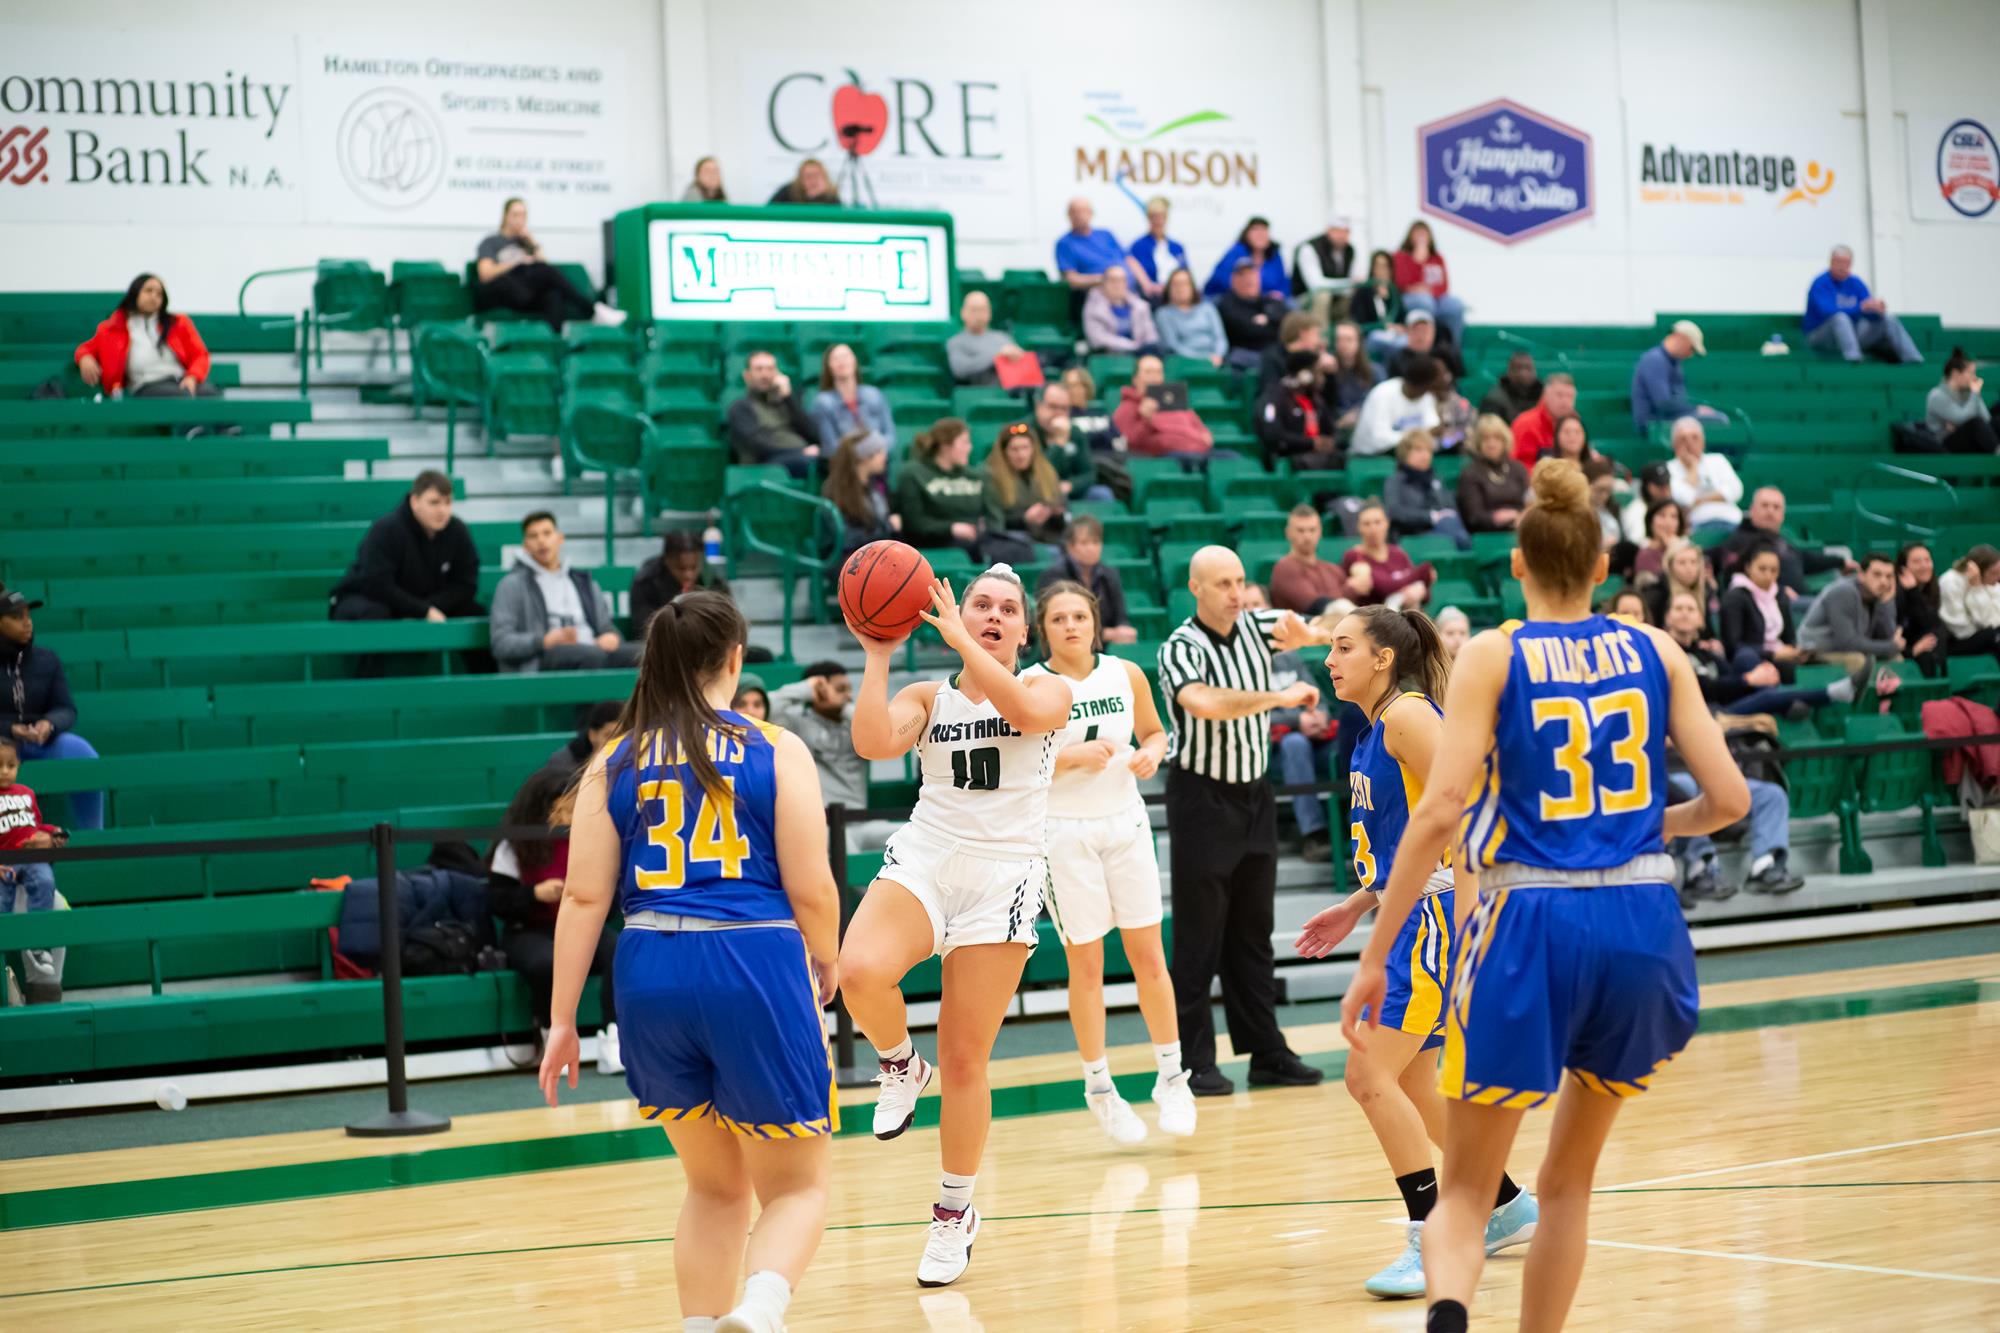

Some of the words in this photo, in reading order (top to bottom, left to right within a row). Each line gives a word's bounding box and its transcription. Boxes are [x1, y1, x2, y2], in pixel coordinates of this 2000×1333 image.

[65, 129, 212, 186] Bank
[1075, 146, 1258, 187] MADISON
[1642, 143, 1796, 192] Advantage
[1518, 629, 1643, 684] WILDCATS
[1068, 697, 1125, 720] STANGS
[951, 747, 1000, 790] 10
[1531, 688, 1653, 822] 33
[634, 775, 750, 890] 34
